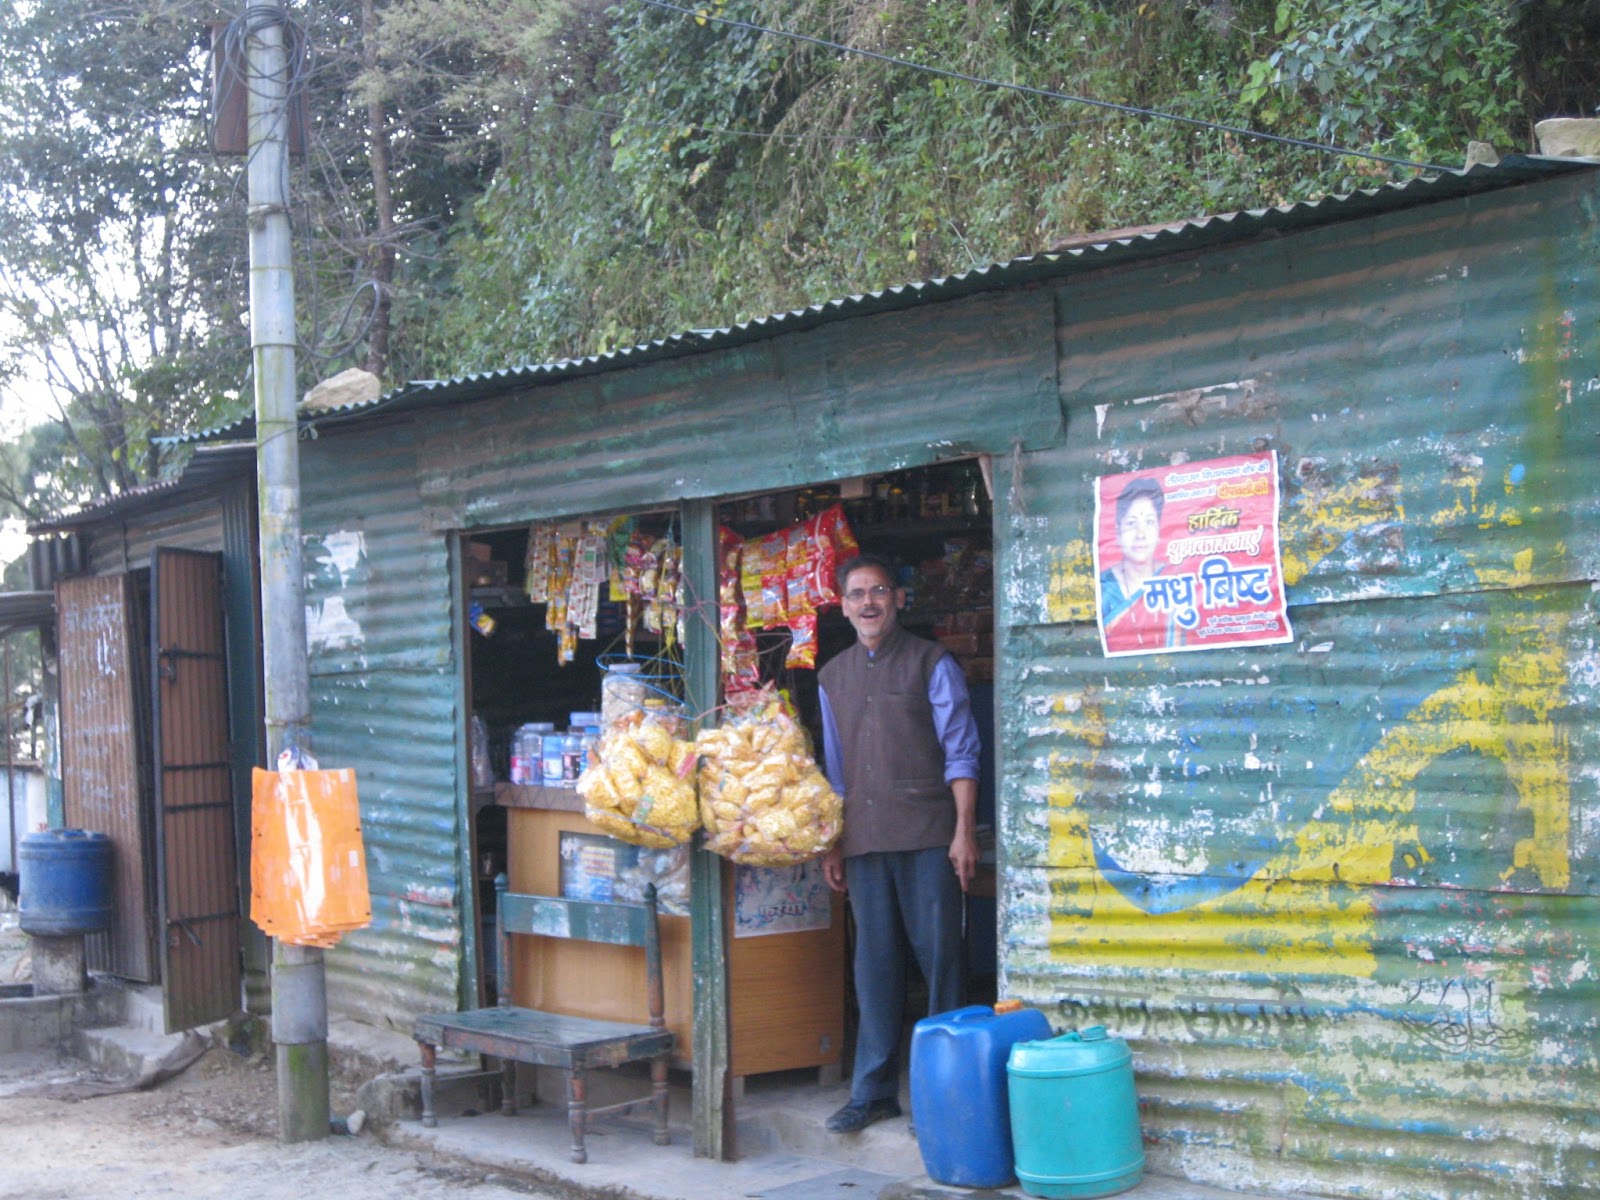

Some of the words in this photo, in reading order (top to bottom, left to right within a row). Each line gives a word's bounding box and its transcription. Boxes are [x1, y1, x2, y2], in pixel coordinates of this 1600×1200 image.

[1188, 506, 1240, 532] हार्दिक
[1143, 575, 1198, 626] मधु
[1201, 556, 1270, 605] बिष्ट
